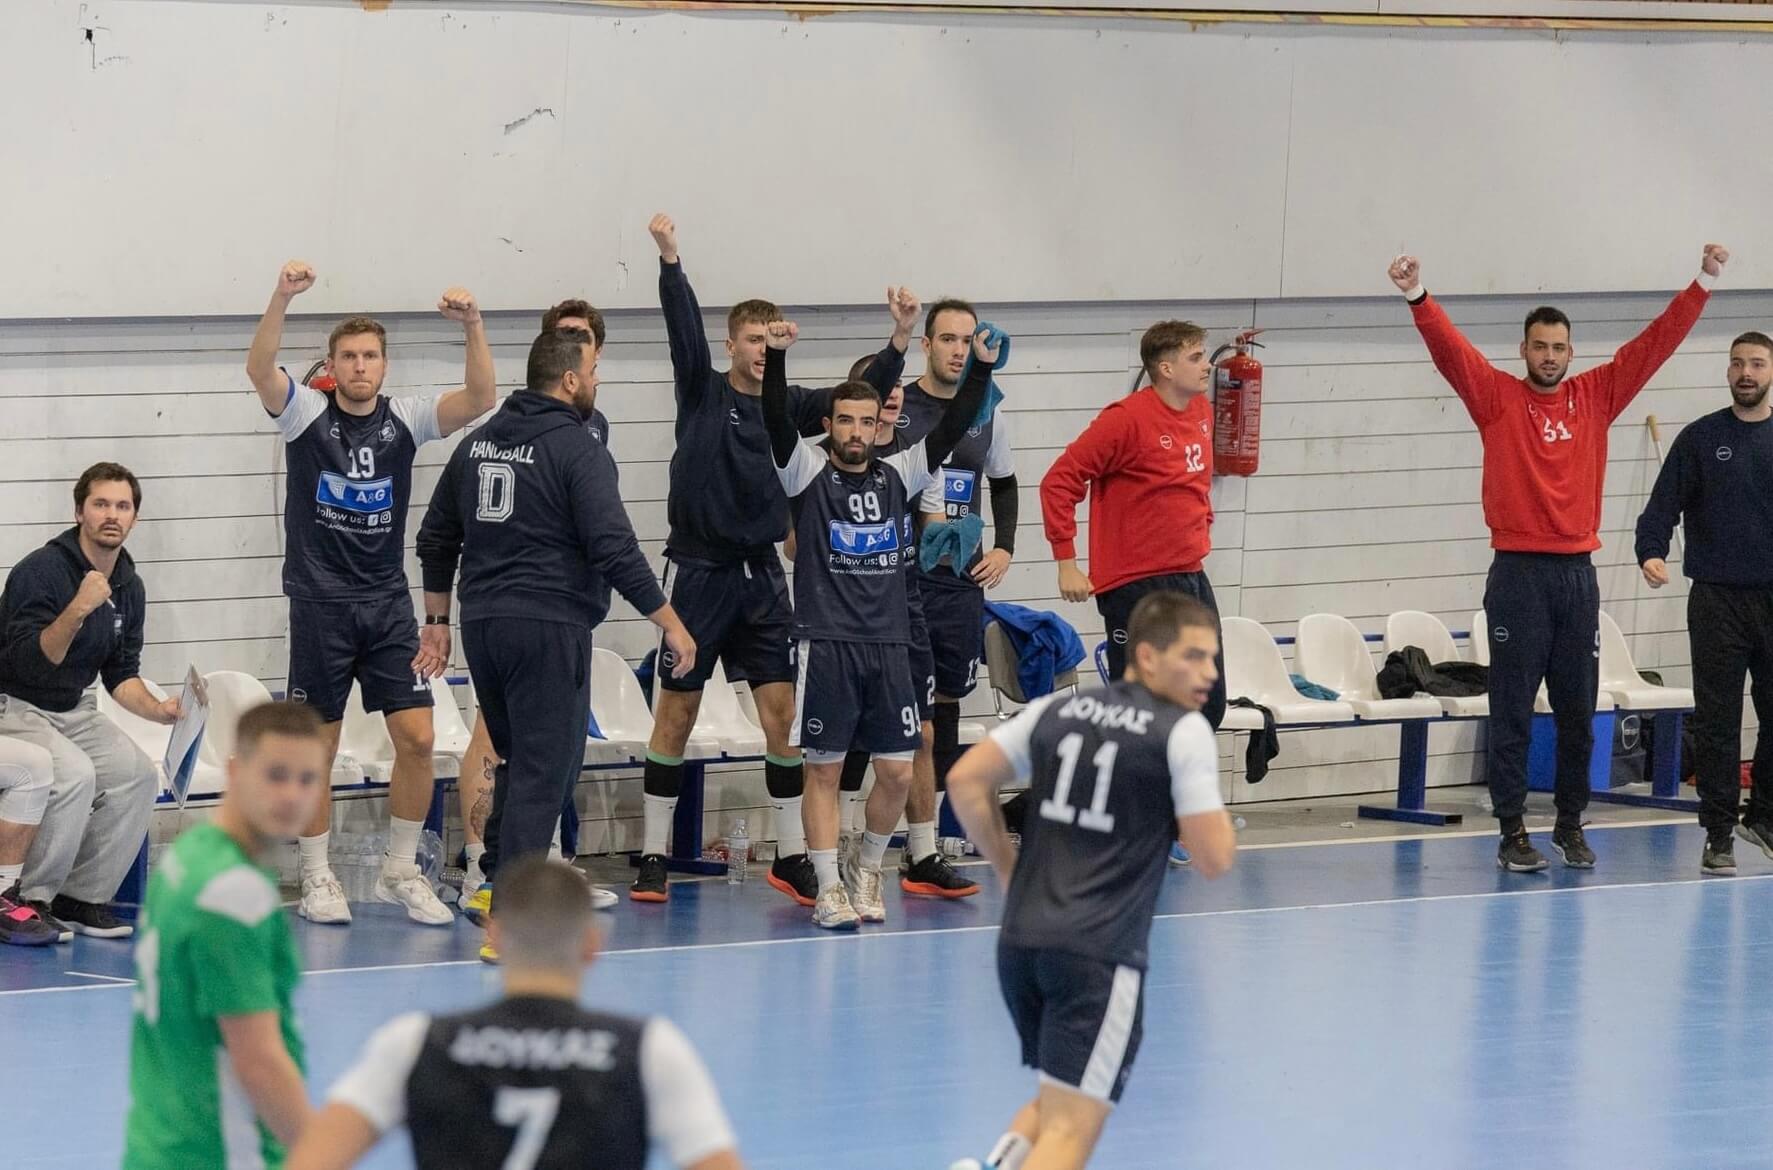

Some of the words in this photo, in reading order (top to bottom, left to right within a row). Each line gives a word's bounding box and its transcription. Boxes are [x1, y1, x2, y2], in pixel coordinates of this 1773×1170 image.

[1543, 416, 1573, 443] 51
[347, 446, 376, 479] 19
[469, 440, 535, 464] HANDBALL
[1184, 443, 1205, 473] 12
[355, 488, 386, 504] A&G
[476, 462, 516, 522] D
[848, 490, 882, 523] 99
[829, 553, 862, 567] Follow
[863, 556, 879, 566] us:
[1057, 695, 1155, 735] ΔΟΥΚΑΣ
[1039, 731, 1119, 833] 11
[493, 1085, 562, 1170] 7
